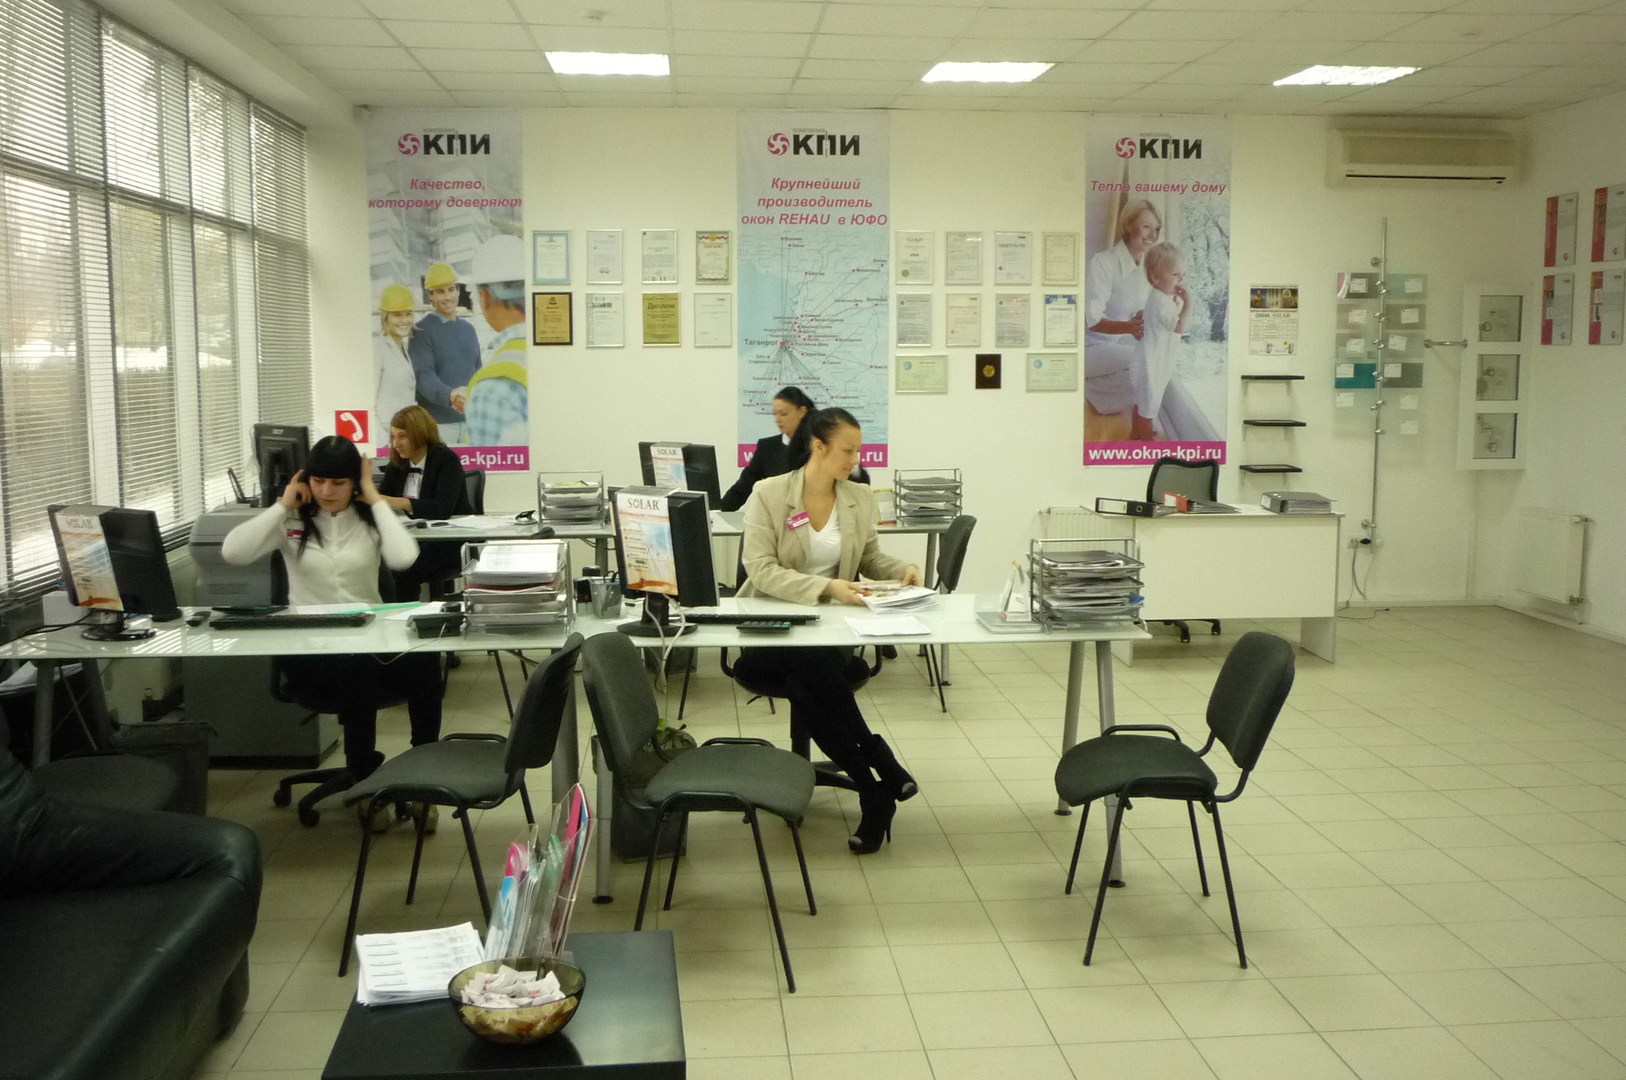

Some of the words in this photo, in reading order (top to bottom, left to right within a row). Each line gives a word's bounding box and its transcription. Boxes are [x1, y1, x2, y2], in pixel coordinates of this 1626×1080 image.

[423, 133, 490, 156] КПИ
[793, 133, 860, 156] КПИ
[1140, 138, 1202, 159] КПИ
[410, 179, 486, 191] Качество,
[771, 177, 861, 191] Крупнейший
[1090, 181, 1131, 192] Тепло
[1135, 183, 1189, 195] вашему
[1192, 181, 1226, 195] дому
[368, 198, 442, 211] которому
[446, 195, 523, 209] доверяют
[757, 195, 873, 209] производитель
[741, 214, 774, 225] окон
[779, 213, 831, 225] REHAU
[838, 215, 846, 225] в
[850, 213, 888, 226] ЮФО
[744, 338, 779, 347] Таганрог
[460, 451, 525, 468] a-kpi.ru
[1088, 445, 1222, 461] www.okna-kpi.ru
[627, 497, 660, 510] SOLAR
